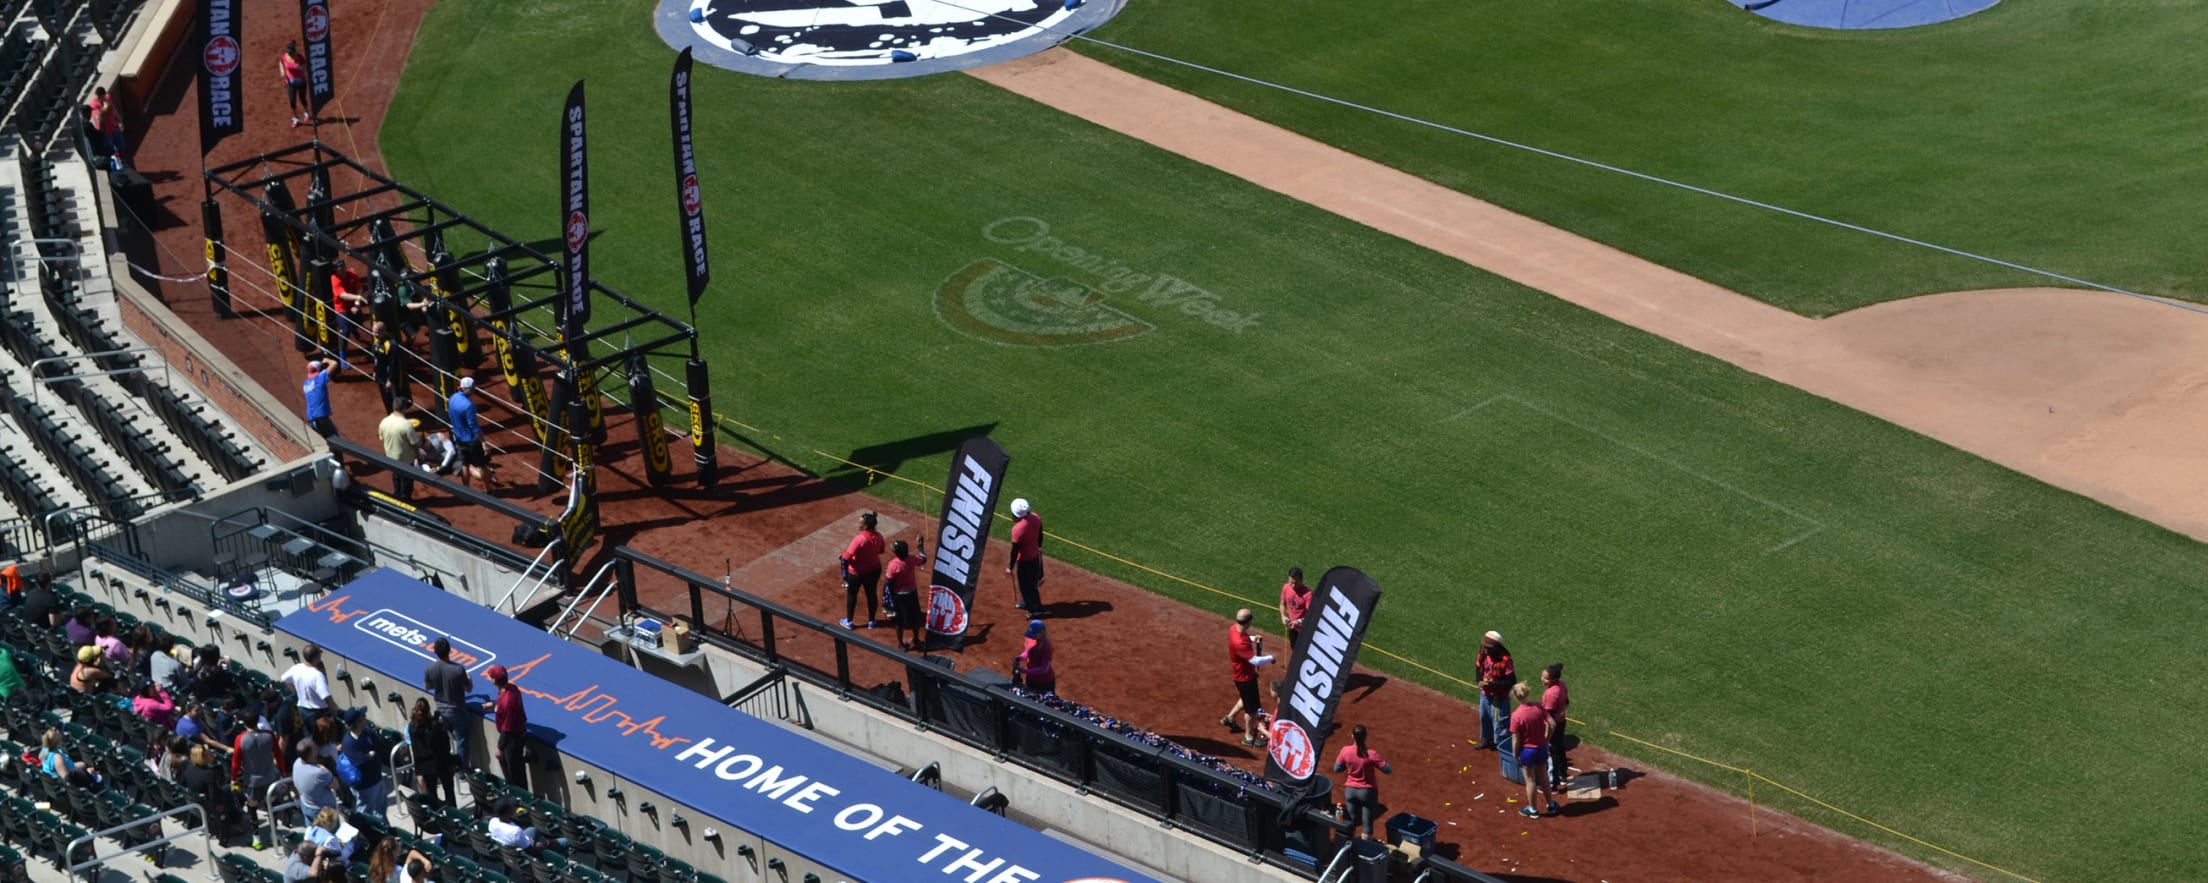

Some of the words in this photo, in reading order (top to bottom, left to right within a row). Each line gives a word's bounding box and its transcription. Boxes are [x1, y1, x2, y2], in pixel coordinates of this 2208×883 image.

[210, 76, 231, 127] RACE
[309, 43, 328, 96] RACE
[569, 105, 583, 211] SPARTAN
[689, 216, 706, 277] RACE
[934, 454, 992, 585] FINISH
[1290, 585, 1360, 728] FINISH
[675, 737, 840, 814] HOME
[833, 802, 923, 841] OF
[917, 833, 1041, 883] THE
